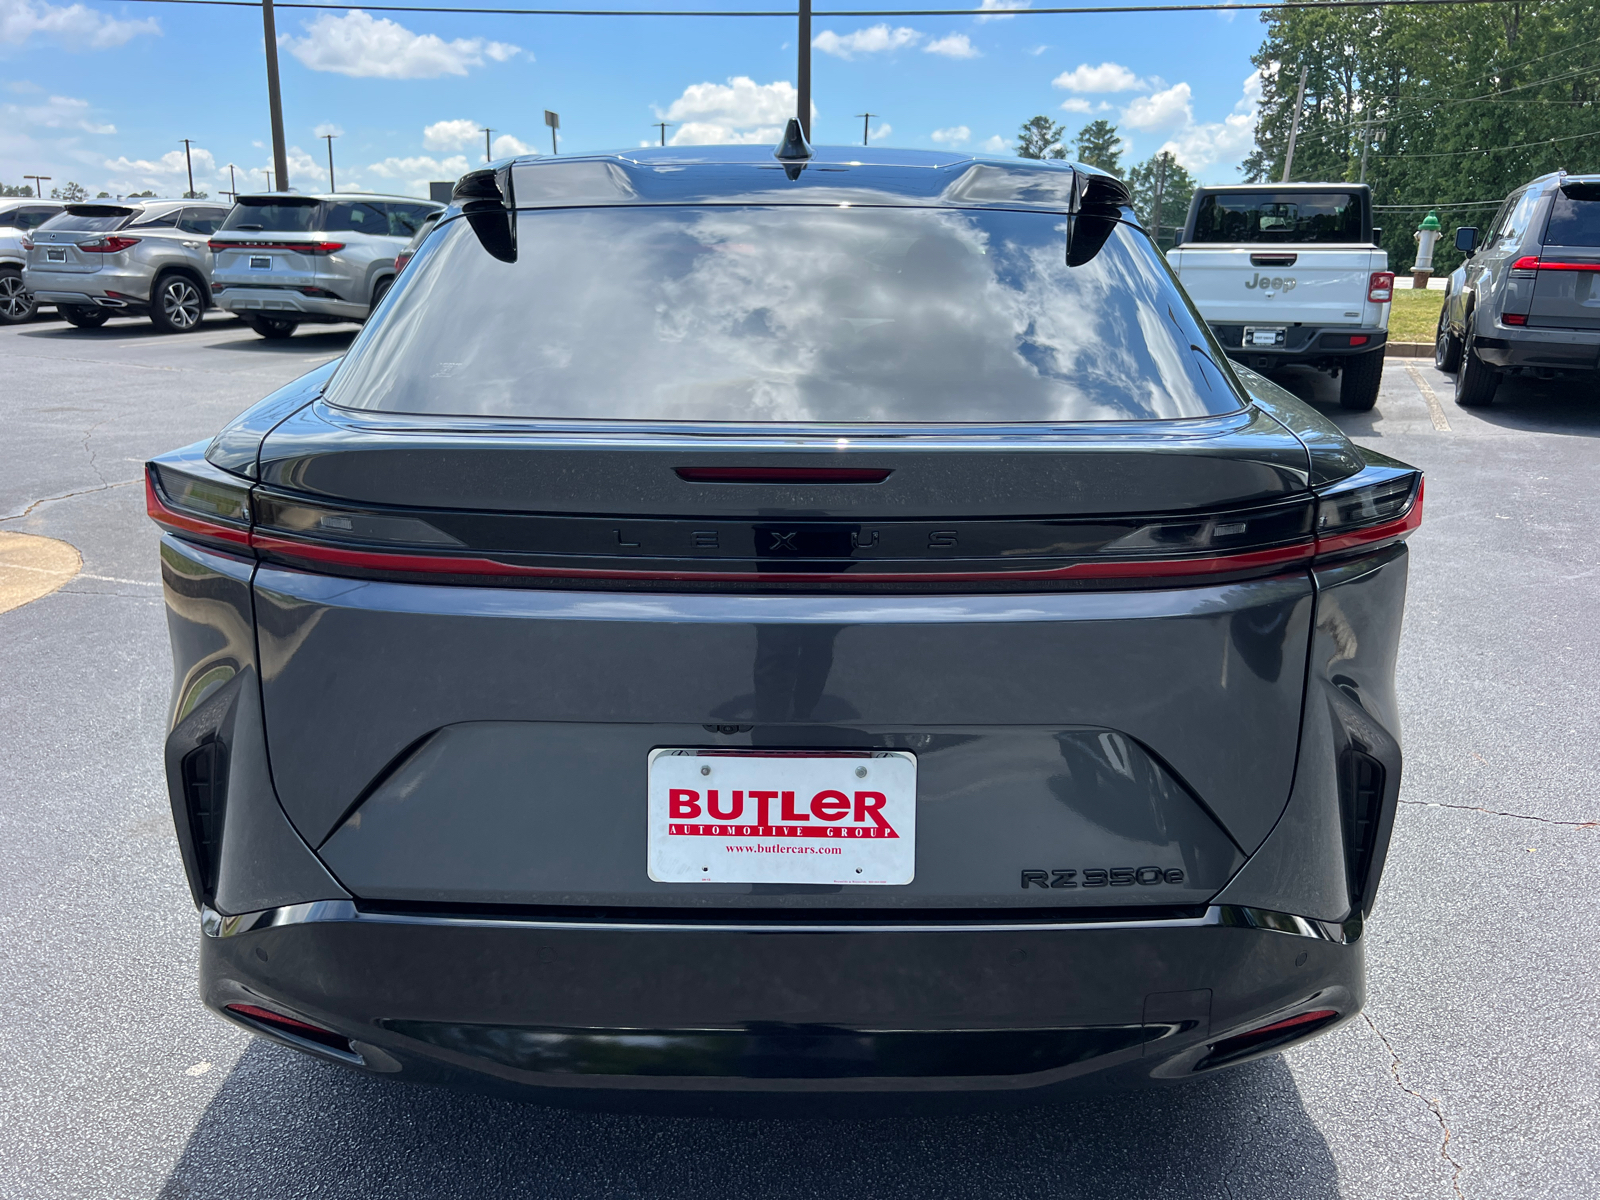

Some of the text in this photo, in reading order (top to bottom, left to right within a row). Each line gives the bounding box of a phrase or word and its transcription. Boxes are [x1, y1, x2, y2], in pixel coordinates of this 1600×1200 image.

[1245, 273, 1297, 293] Jeep
[612, 529, 959, 550] LEXUS
[669, 825, 892, 838] AUTOMOTIVE GROUP
[725, 844, 842, 855] www.butlercars.com
